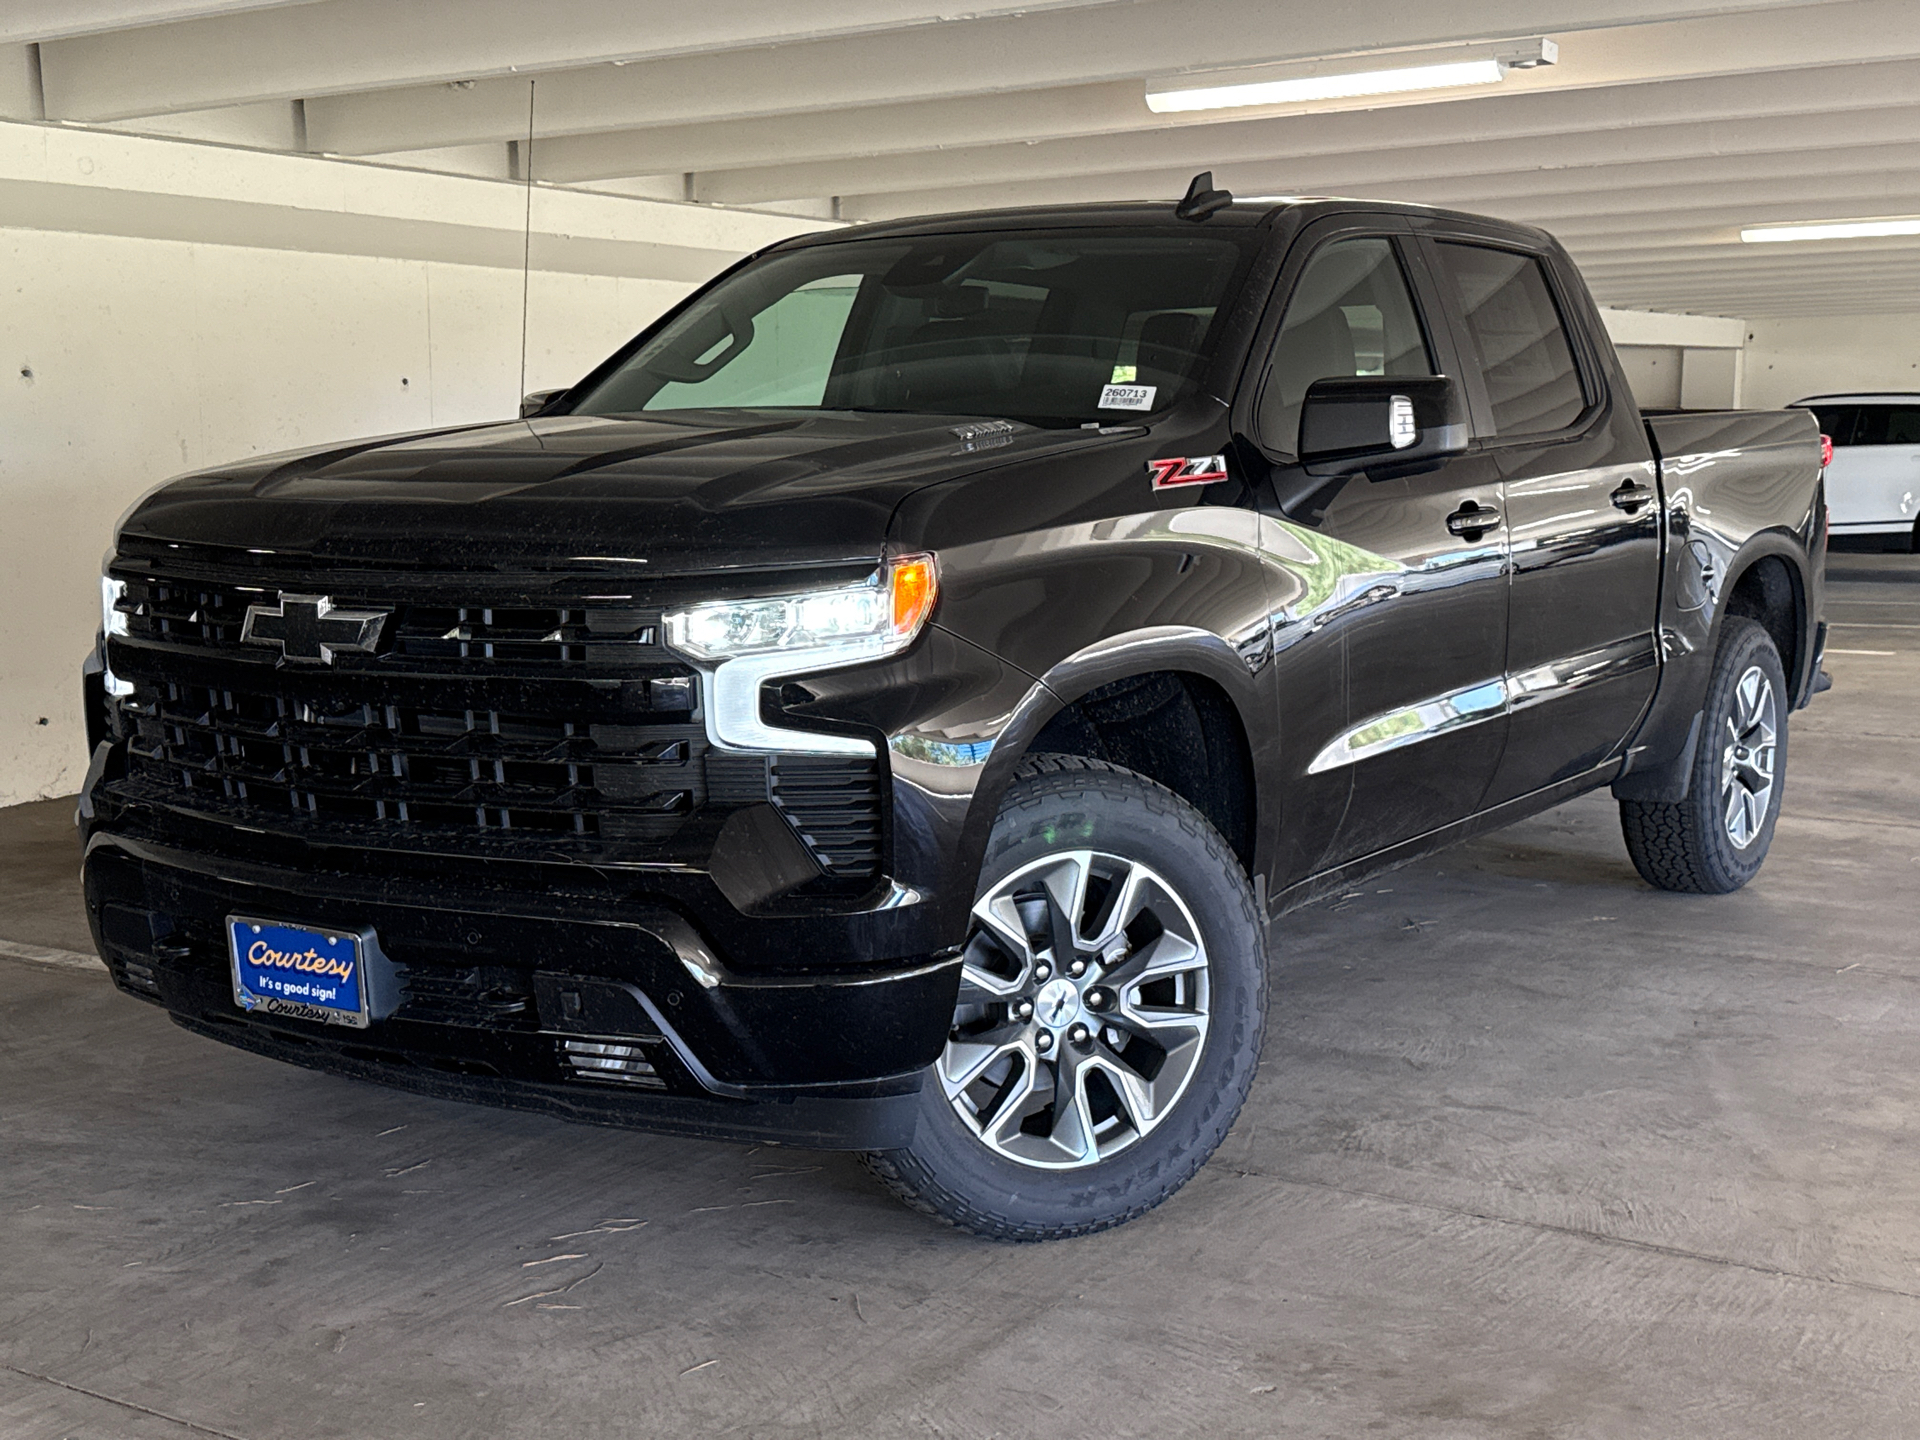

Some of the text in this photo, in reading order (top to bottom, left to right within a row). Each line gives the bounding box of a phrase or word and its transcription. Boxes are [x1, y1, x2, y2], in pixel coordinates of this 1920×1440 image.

[1104, 388, 1148, 398] 260713
[1147, 455, 1228, 490] Z71
[248, 941, 353, 983] Courtesy
[259, 975, 336, 1001] It's a good sign!
[267, 997, 330, 1025] Courtesy
